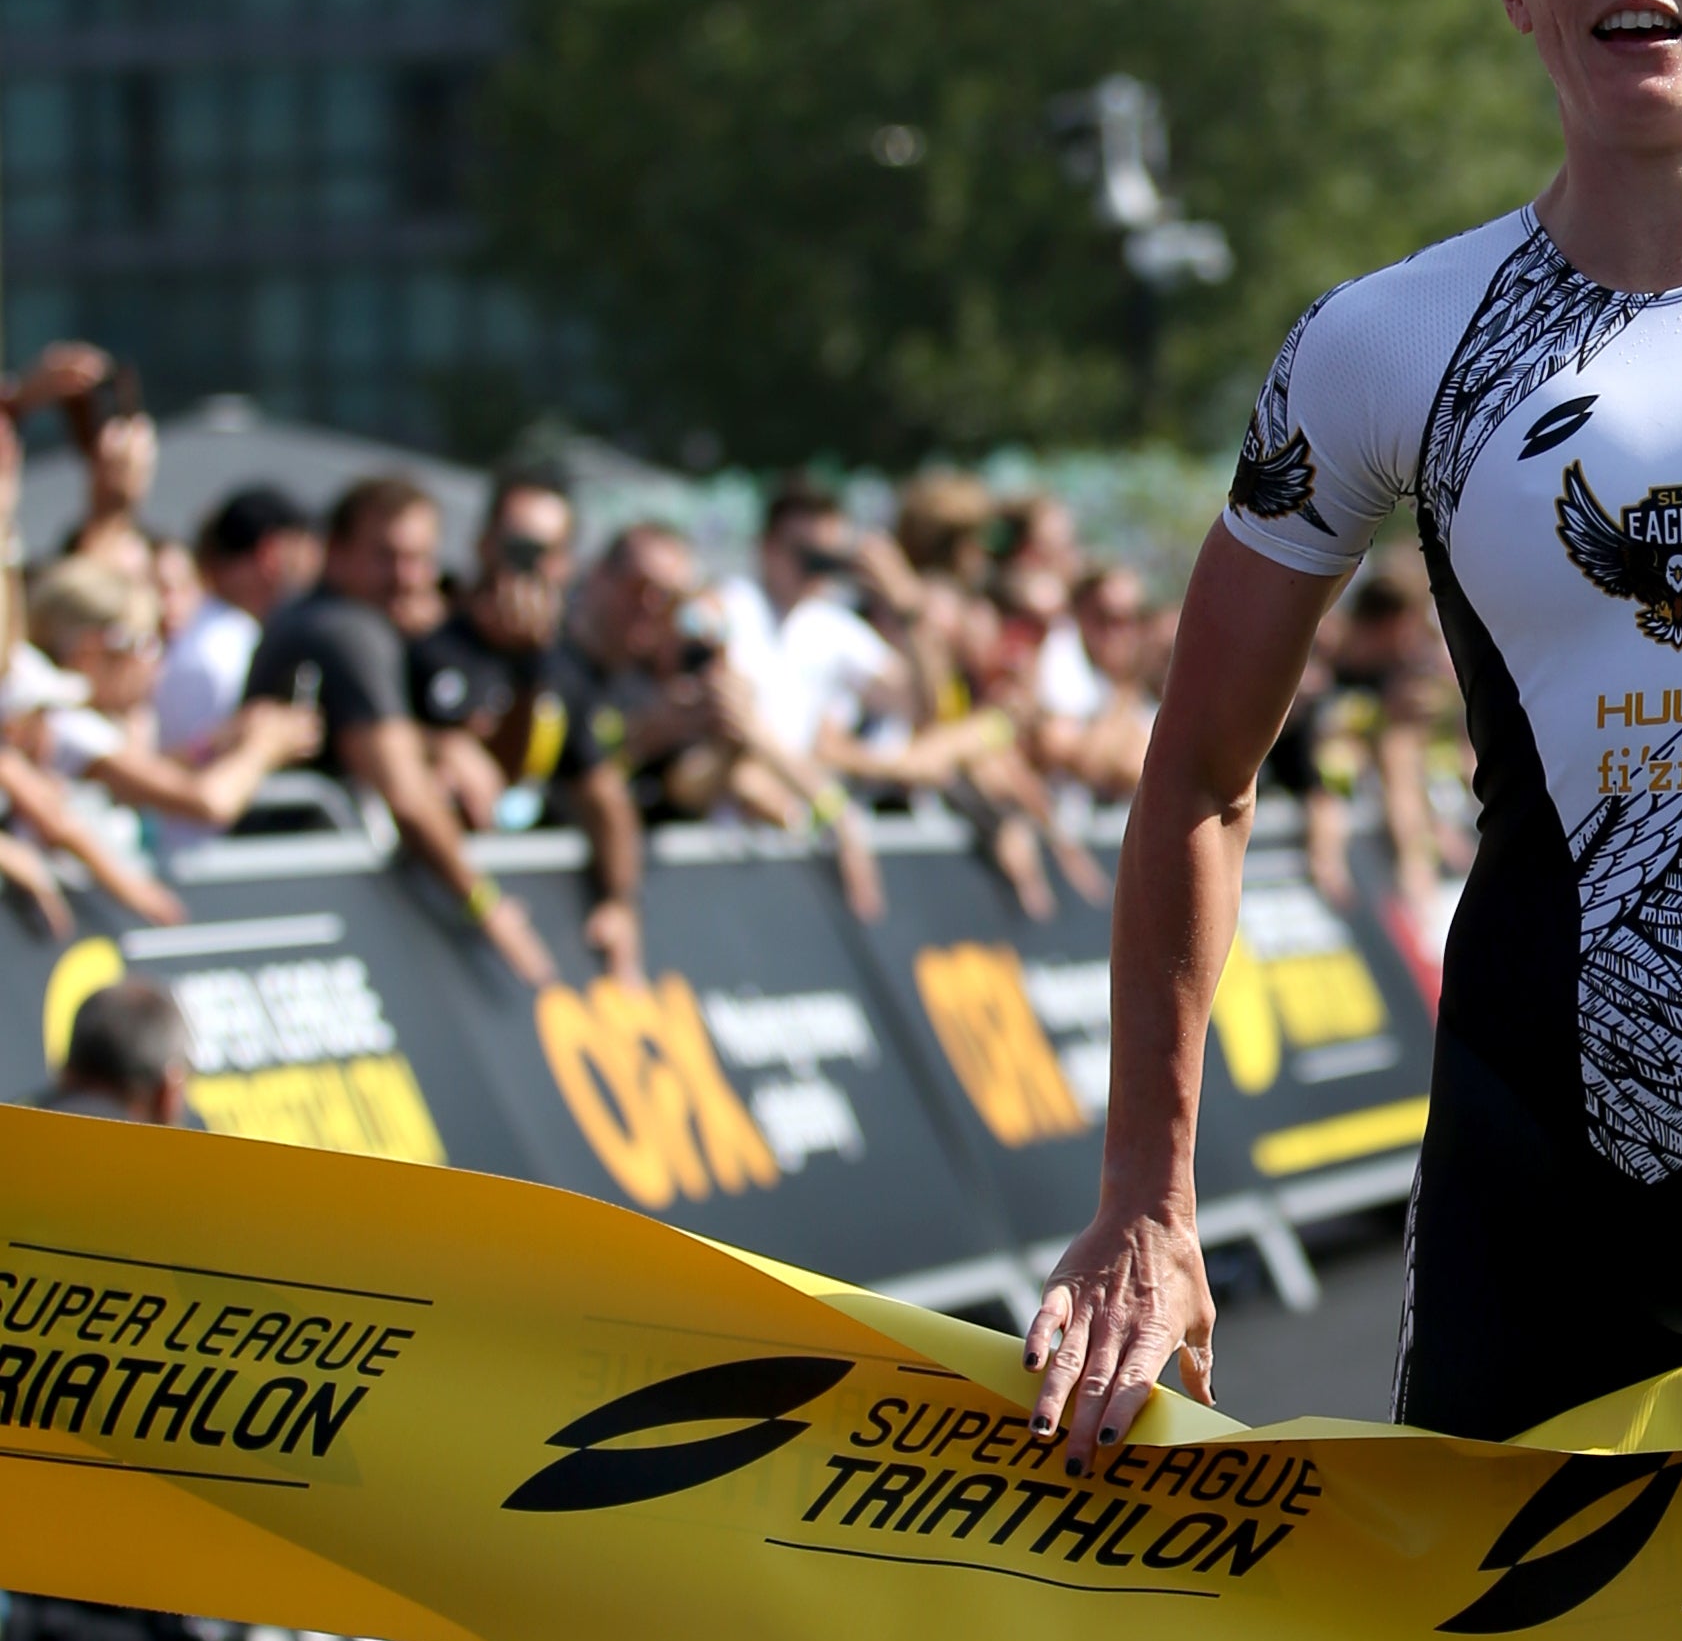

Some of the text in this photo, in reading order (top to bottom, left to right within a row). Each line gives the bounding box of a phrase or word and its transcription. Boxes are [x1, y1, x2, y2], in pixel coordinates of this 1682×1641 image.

[163, 1301, 416, 1377] LEAGUE
[0, 1343, 370, 1458] RIATHLON
[850, 1397, 1323, 1517] SUPER EAGUE
[802, 1454, 1295, 1577] TRIATHLON
